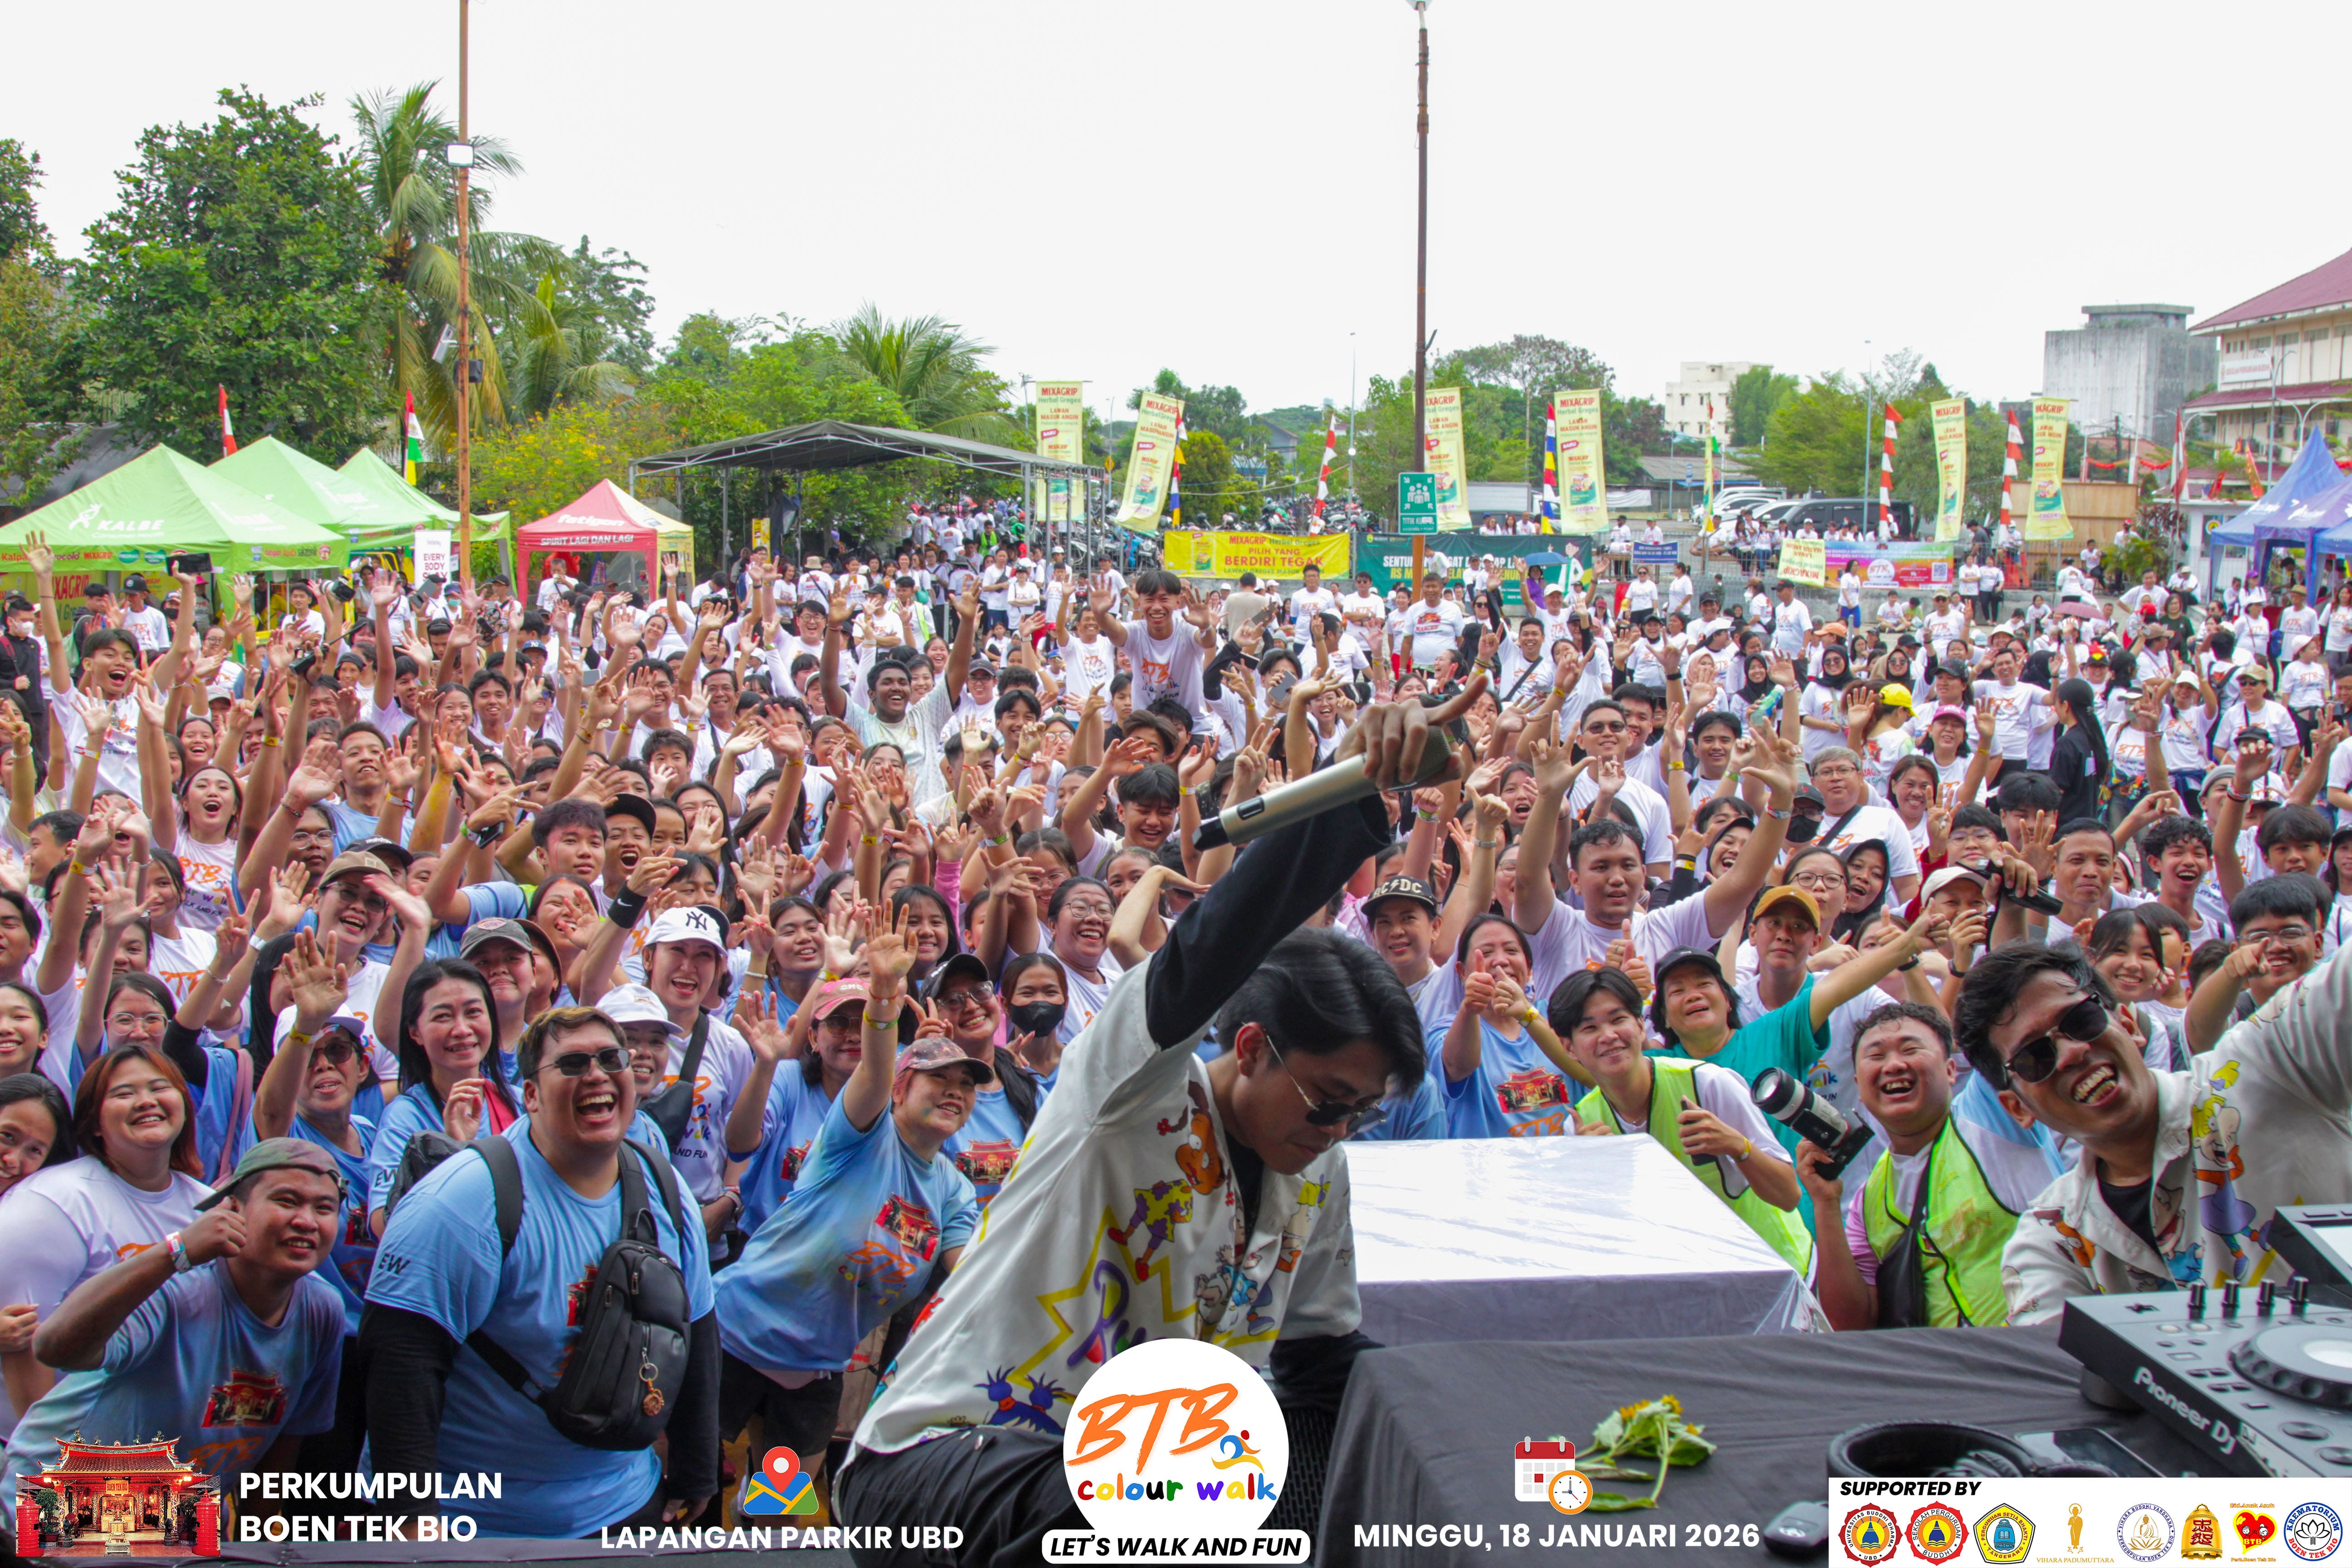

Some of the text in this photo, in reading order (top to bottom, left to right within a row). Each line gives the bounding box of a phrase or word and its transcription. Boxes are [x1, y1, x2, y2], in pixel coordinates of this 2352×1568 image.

[1042, 387, 1078, 396] MIXAGRIP
[1426, 396, 1455, 406] IXAGRIP
[1560, 397, 1594, 407] MIXAGRIP
[97, 520, 165, 531] KALBE
[558, 514, 624, 526] fatigon
[541, 534, 634, 546] SPIRIT LAGI DAN LAGI
[1230, 536, 1265, 544] MIXAGRIP
[54, 552, 81, 561] rocold
[1225, 556, 1323, 567] BERDIRI TEGAK
[686, 911, 707, 931] NY
[2134, 1367, 2211, 1431] Pioneer
